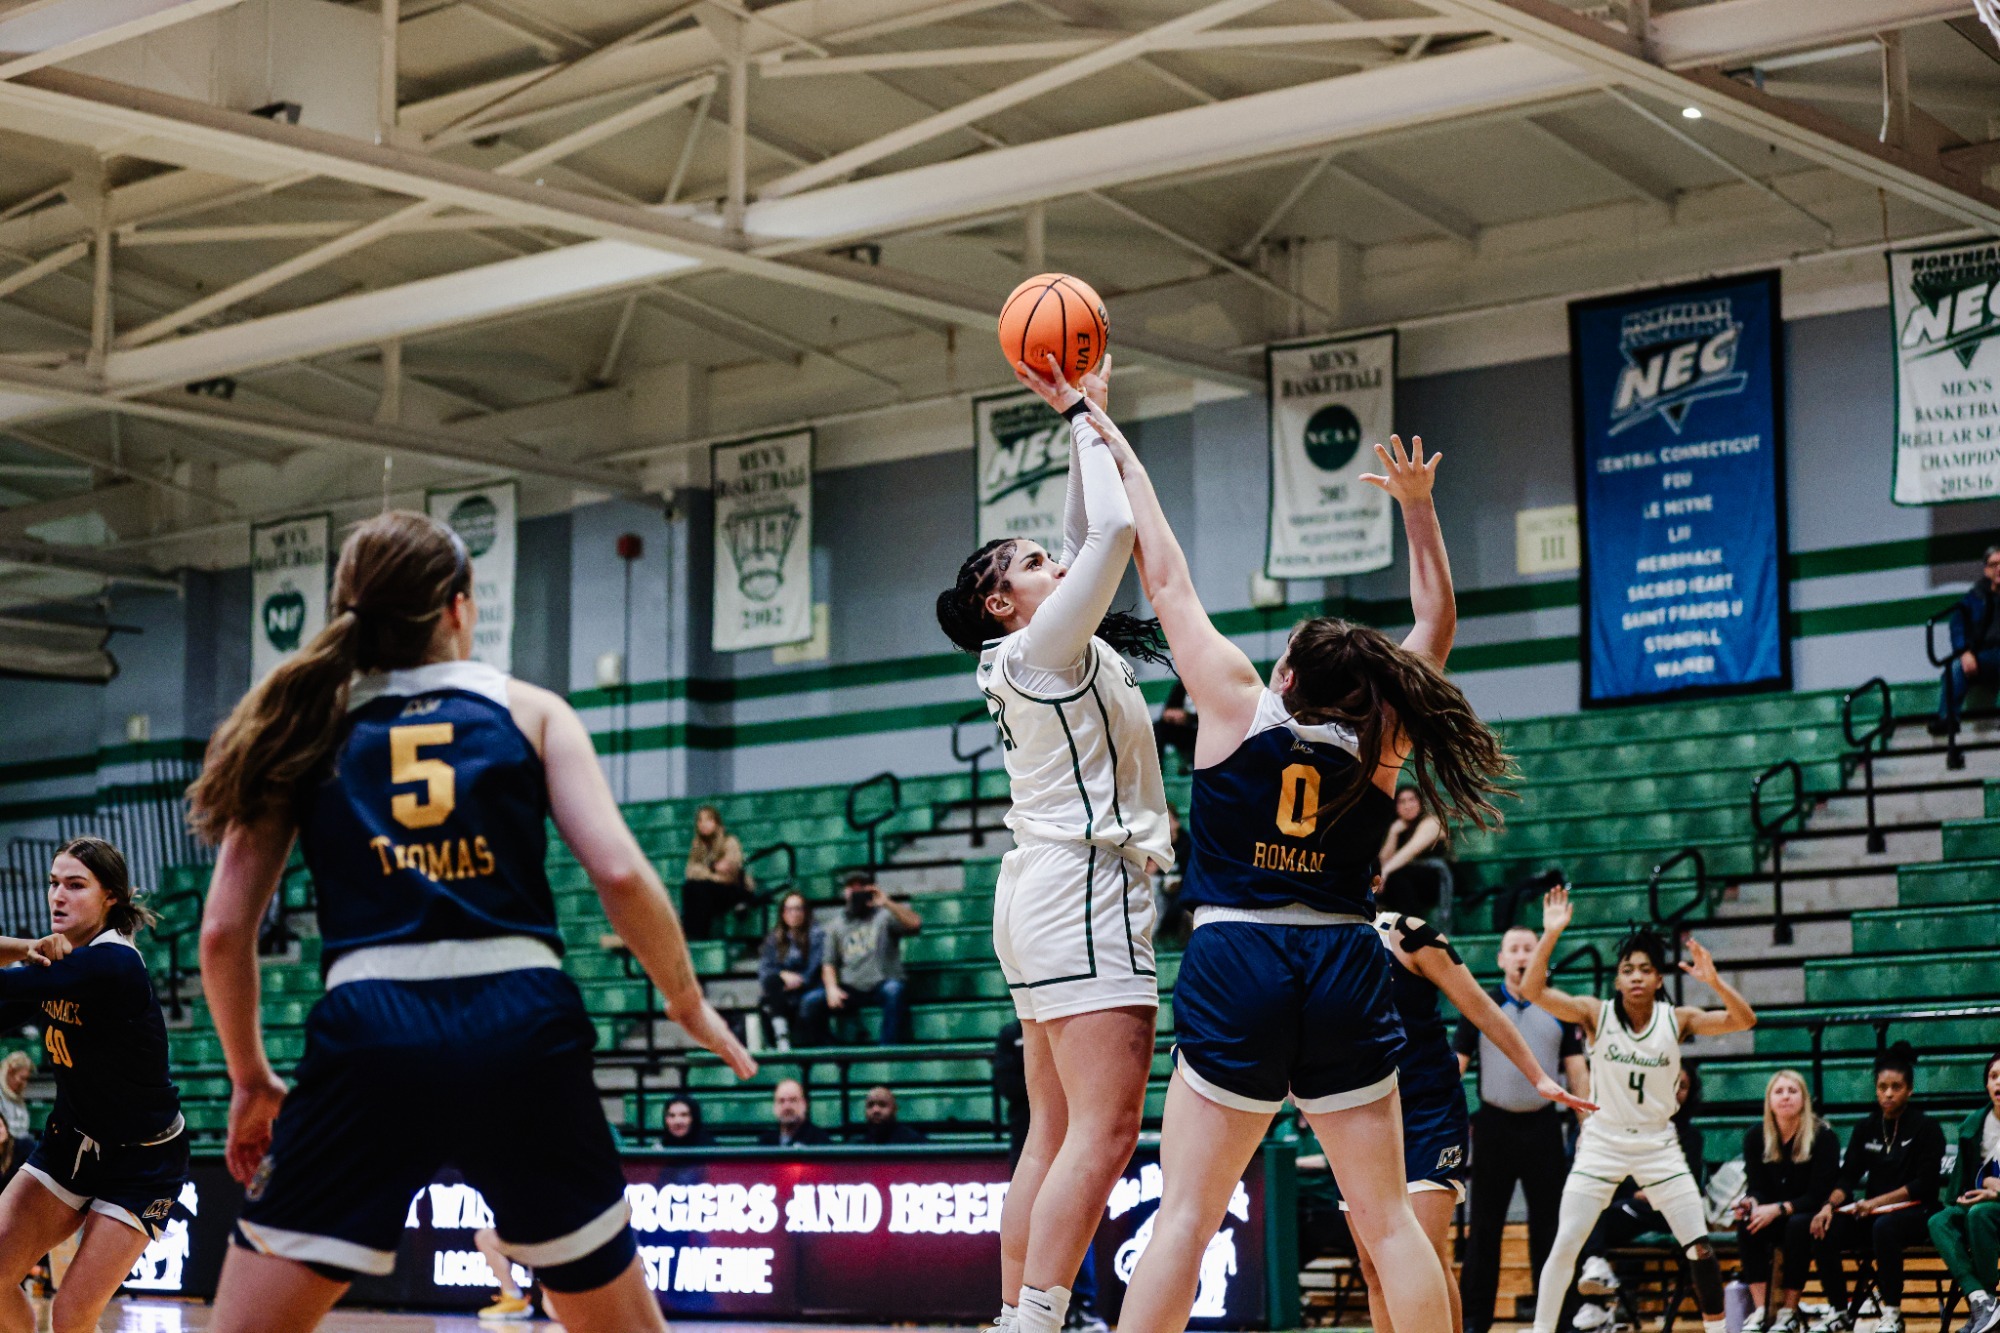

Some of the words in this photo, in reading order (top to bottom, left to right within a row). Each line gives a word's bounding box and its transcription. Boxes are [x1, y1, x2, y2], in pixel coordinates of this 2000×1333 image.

[1615, 329, 1738, 410] NEC
[1941, 379, 1993, 398] MEN'S
[1660, 434, 1761, 464] CONNECTICUT
[1627, 577, 1688, 603] SACRED
[1687, 571, 1734, 594] HEART
[1621, 606, 1667, 631] SAINT
[1667, 599, 1730, 624] FRANCIS
[1731, 597, 1744, 617] U
[389, 722, 455, 830] 5
[1275, 763, 1321, 838] 0
[1252, 841, 1325, 873] ROMAN
[45, 1024, 73, 1069] 40
[1603, 1043, 1670, 1068] Seahawks
[1628, 1071, 1646, 1104] 4
[785, 1182, 883, 1234] AND
[674, 1246, 774, 1294] AVENUE
